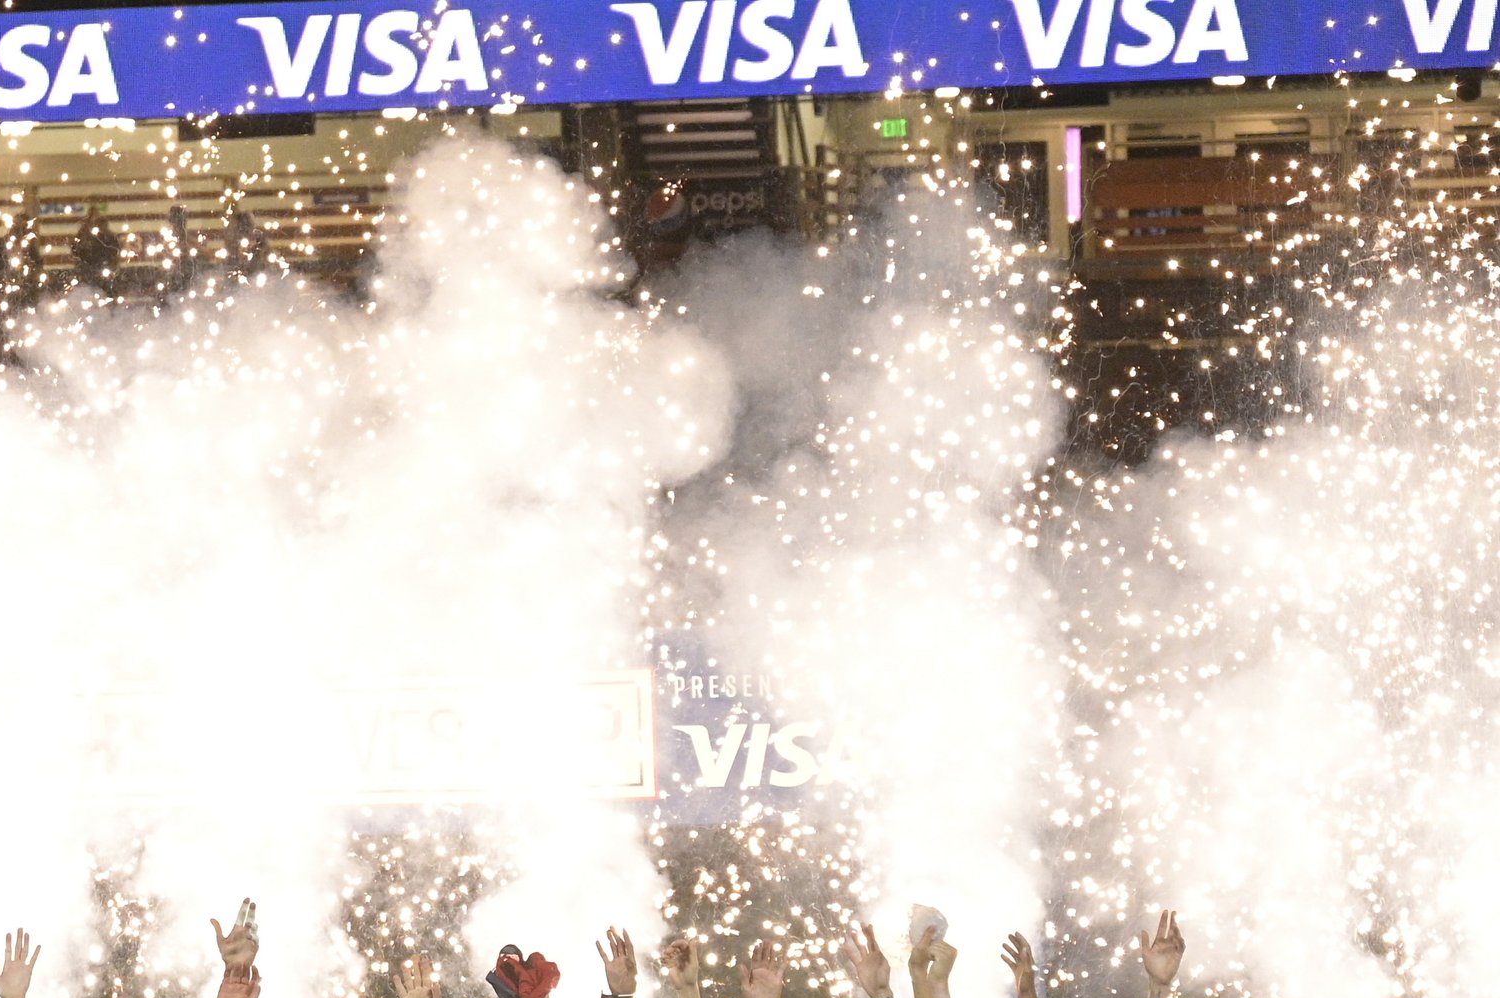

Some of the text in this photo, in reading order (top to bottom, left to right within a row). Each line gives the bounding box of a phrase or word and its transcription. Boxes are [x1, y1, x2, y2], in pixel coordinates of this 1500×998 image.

[237, 9, 489, 98] VISA
[611, 0, 868, 85] VISA
[1008, 0, 1249, 68] VISA
